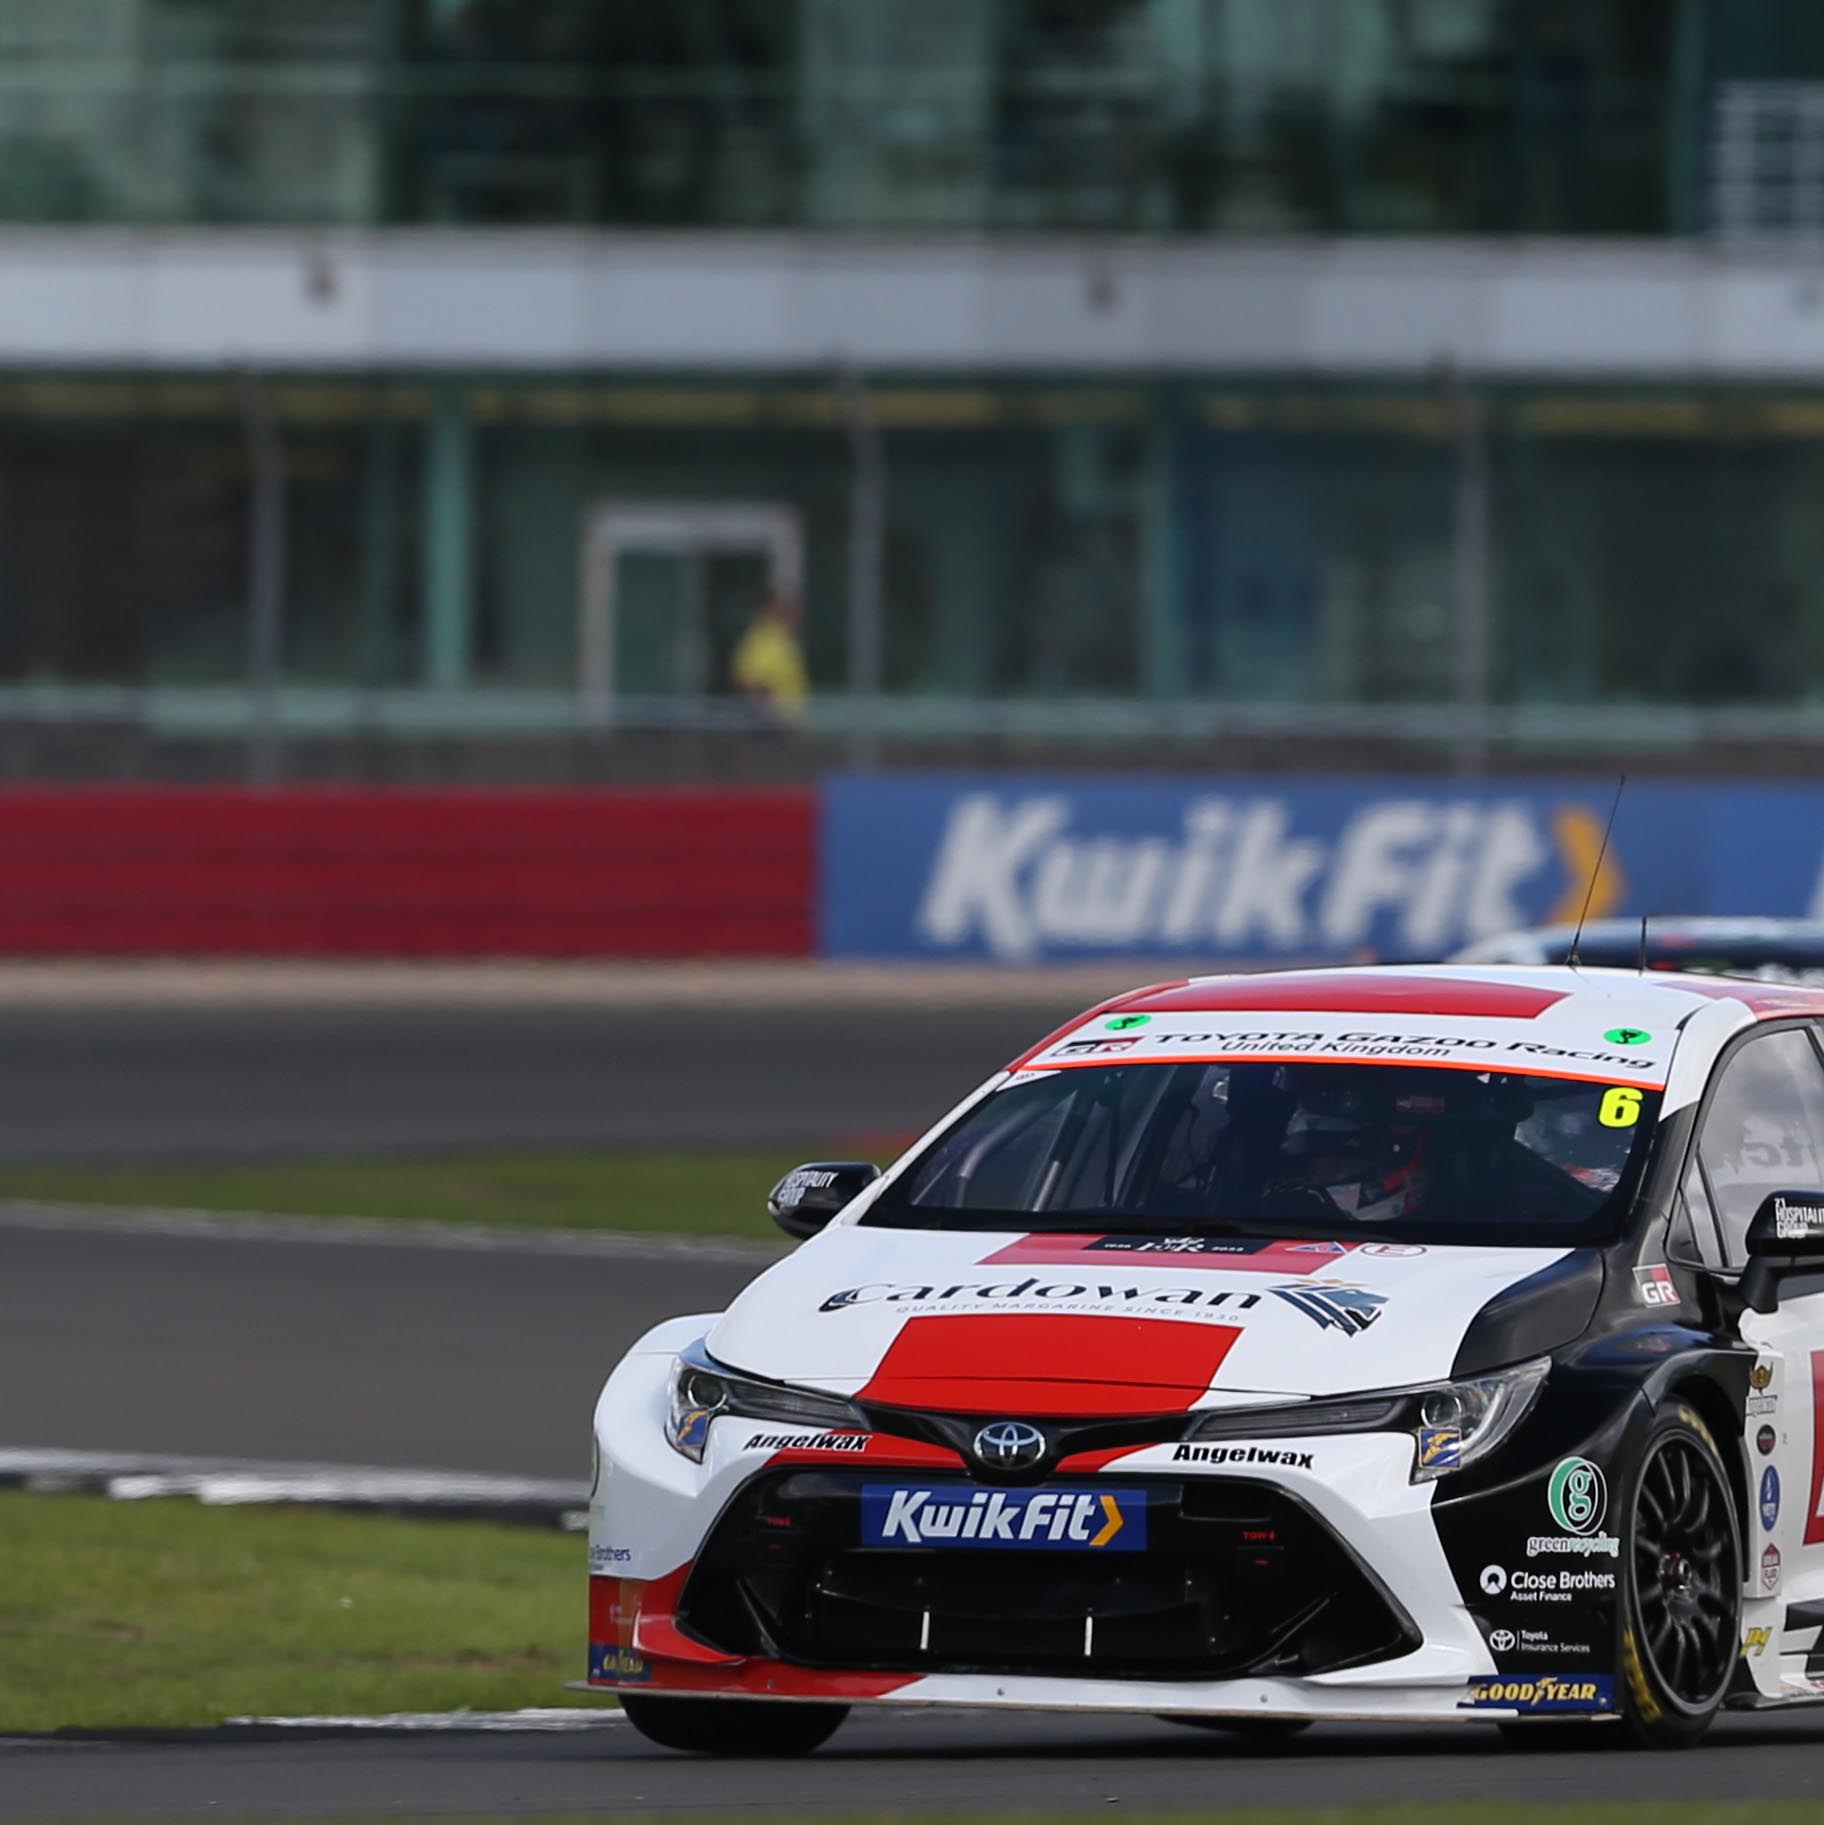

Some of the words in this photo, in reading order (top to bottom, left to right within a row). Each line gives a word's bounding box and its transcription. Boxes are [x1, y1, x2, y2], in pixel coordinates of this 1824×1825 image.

[1154, 1032, 1324, 1044] TOYOTA
[1337, 1032, 1498, 1049] GAZOO
[1507, 1041, 1656, 1069] Racing
[1221, 1041, 1316, 1051] United
[1320, 1042, 1452, 1056] Kingdom
[1597, 1086, 1644, 1129] 6
[1642, 1280, 1679, 1305] GR
[896, 1303, 985, 1313] QUALITY
[991, 1302, 1114, 1312] MARGARINE
[1125, 1305, 1185, 1318] SINCE
[743, 1433, 871, 1452] Angelwax
[1171, 1443, 1315, 1470] Angelwax
[1510, 1570, 1557, 1589] Close
[1559, 1570, 1616, 1589] Brothers
[1509, 1590, 1537, 1601] Asset
[1539, 1590, 1573, 1602] Finance
[1521, 1629, 1549, 1642] Toyota
[1521, 1642, 1558, 1653] Insurance
[1560, 1642, 1591, 1653] Services
[1473, 1682, 1597, 1701] GOODYEAR
